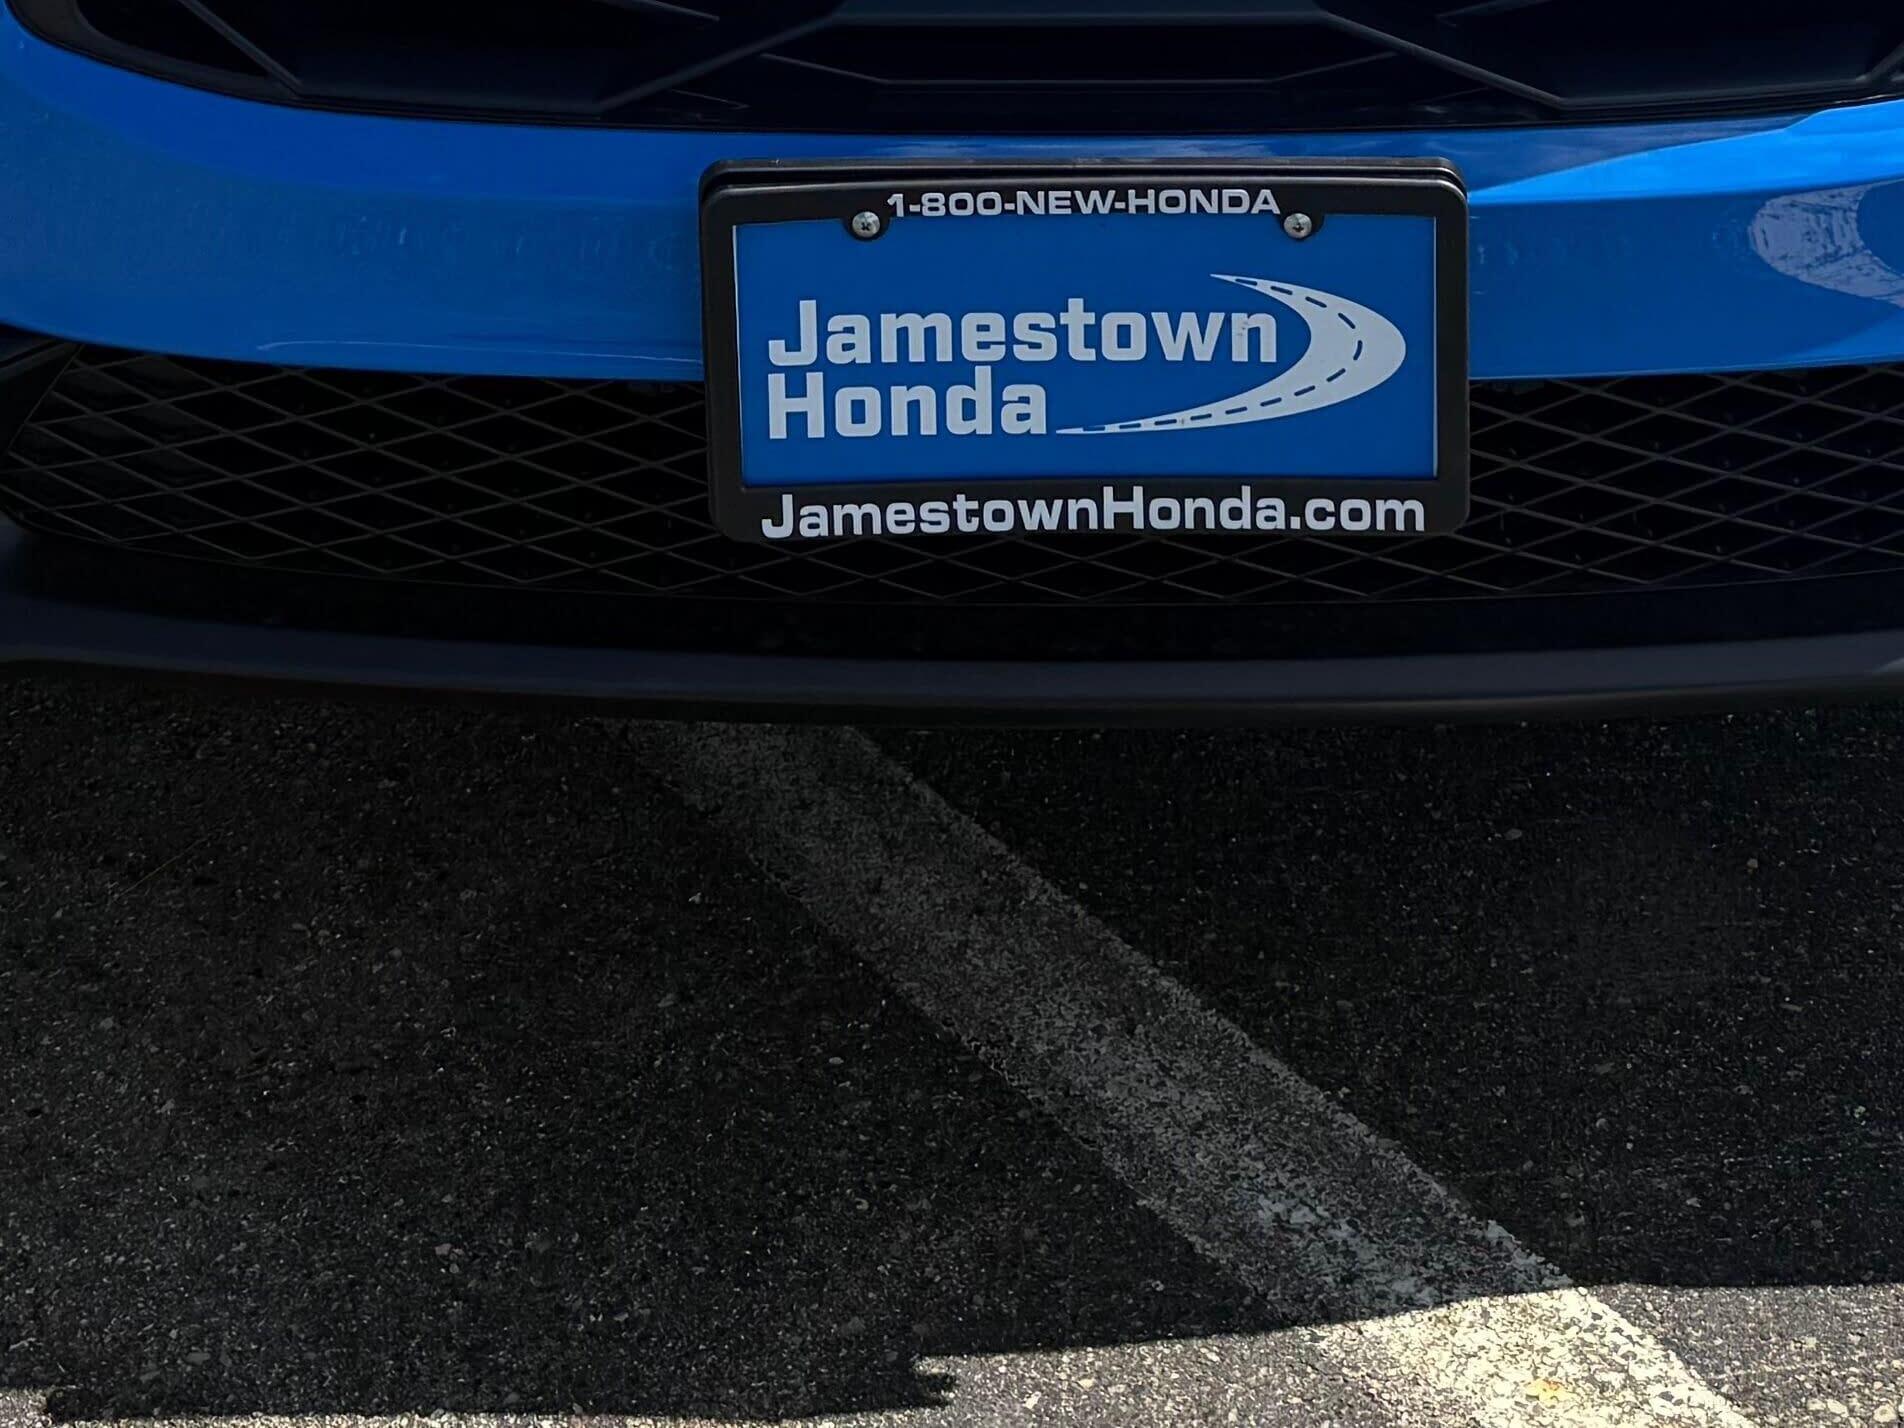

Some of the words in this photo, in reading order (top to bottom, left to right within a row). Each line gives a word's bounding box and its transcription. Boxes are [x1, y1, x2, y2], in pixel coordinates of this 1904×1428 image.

[886, 187, 1282, 217] 1-800-NEW-HONDA
[768, 297, 1278, 367] Jamestown
[768, 365, 1048, 440] Honda
[761, 485, 1425, 539] JamestownHonda.com
